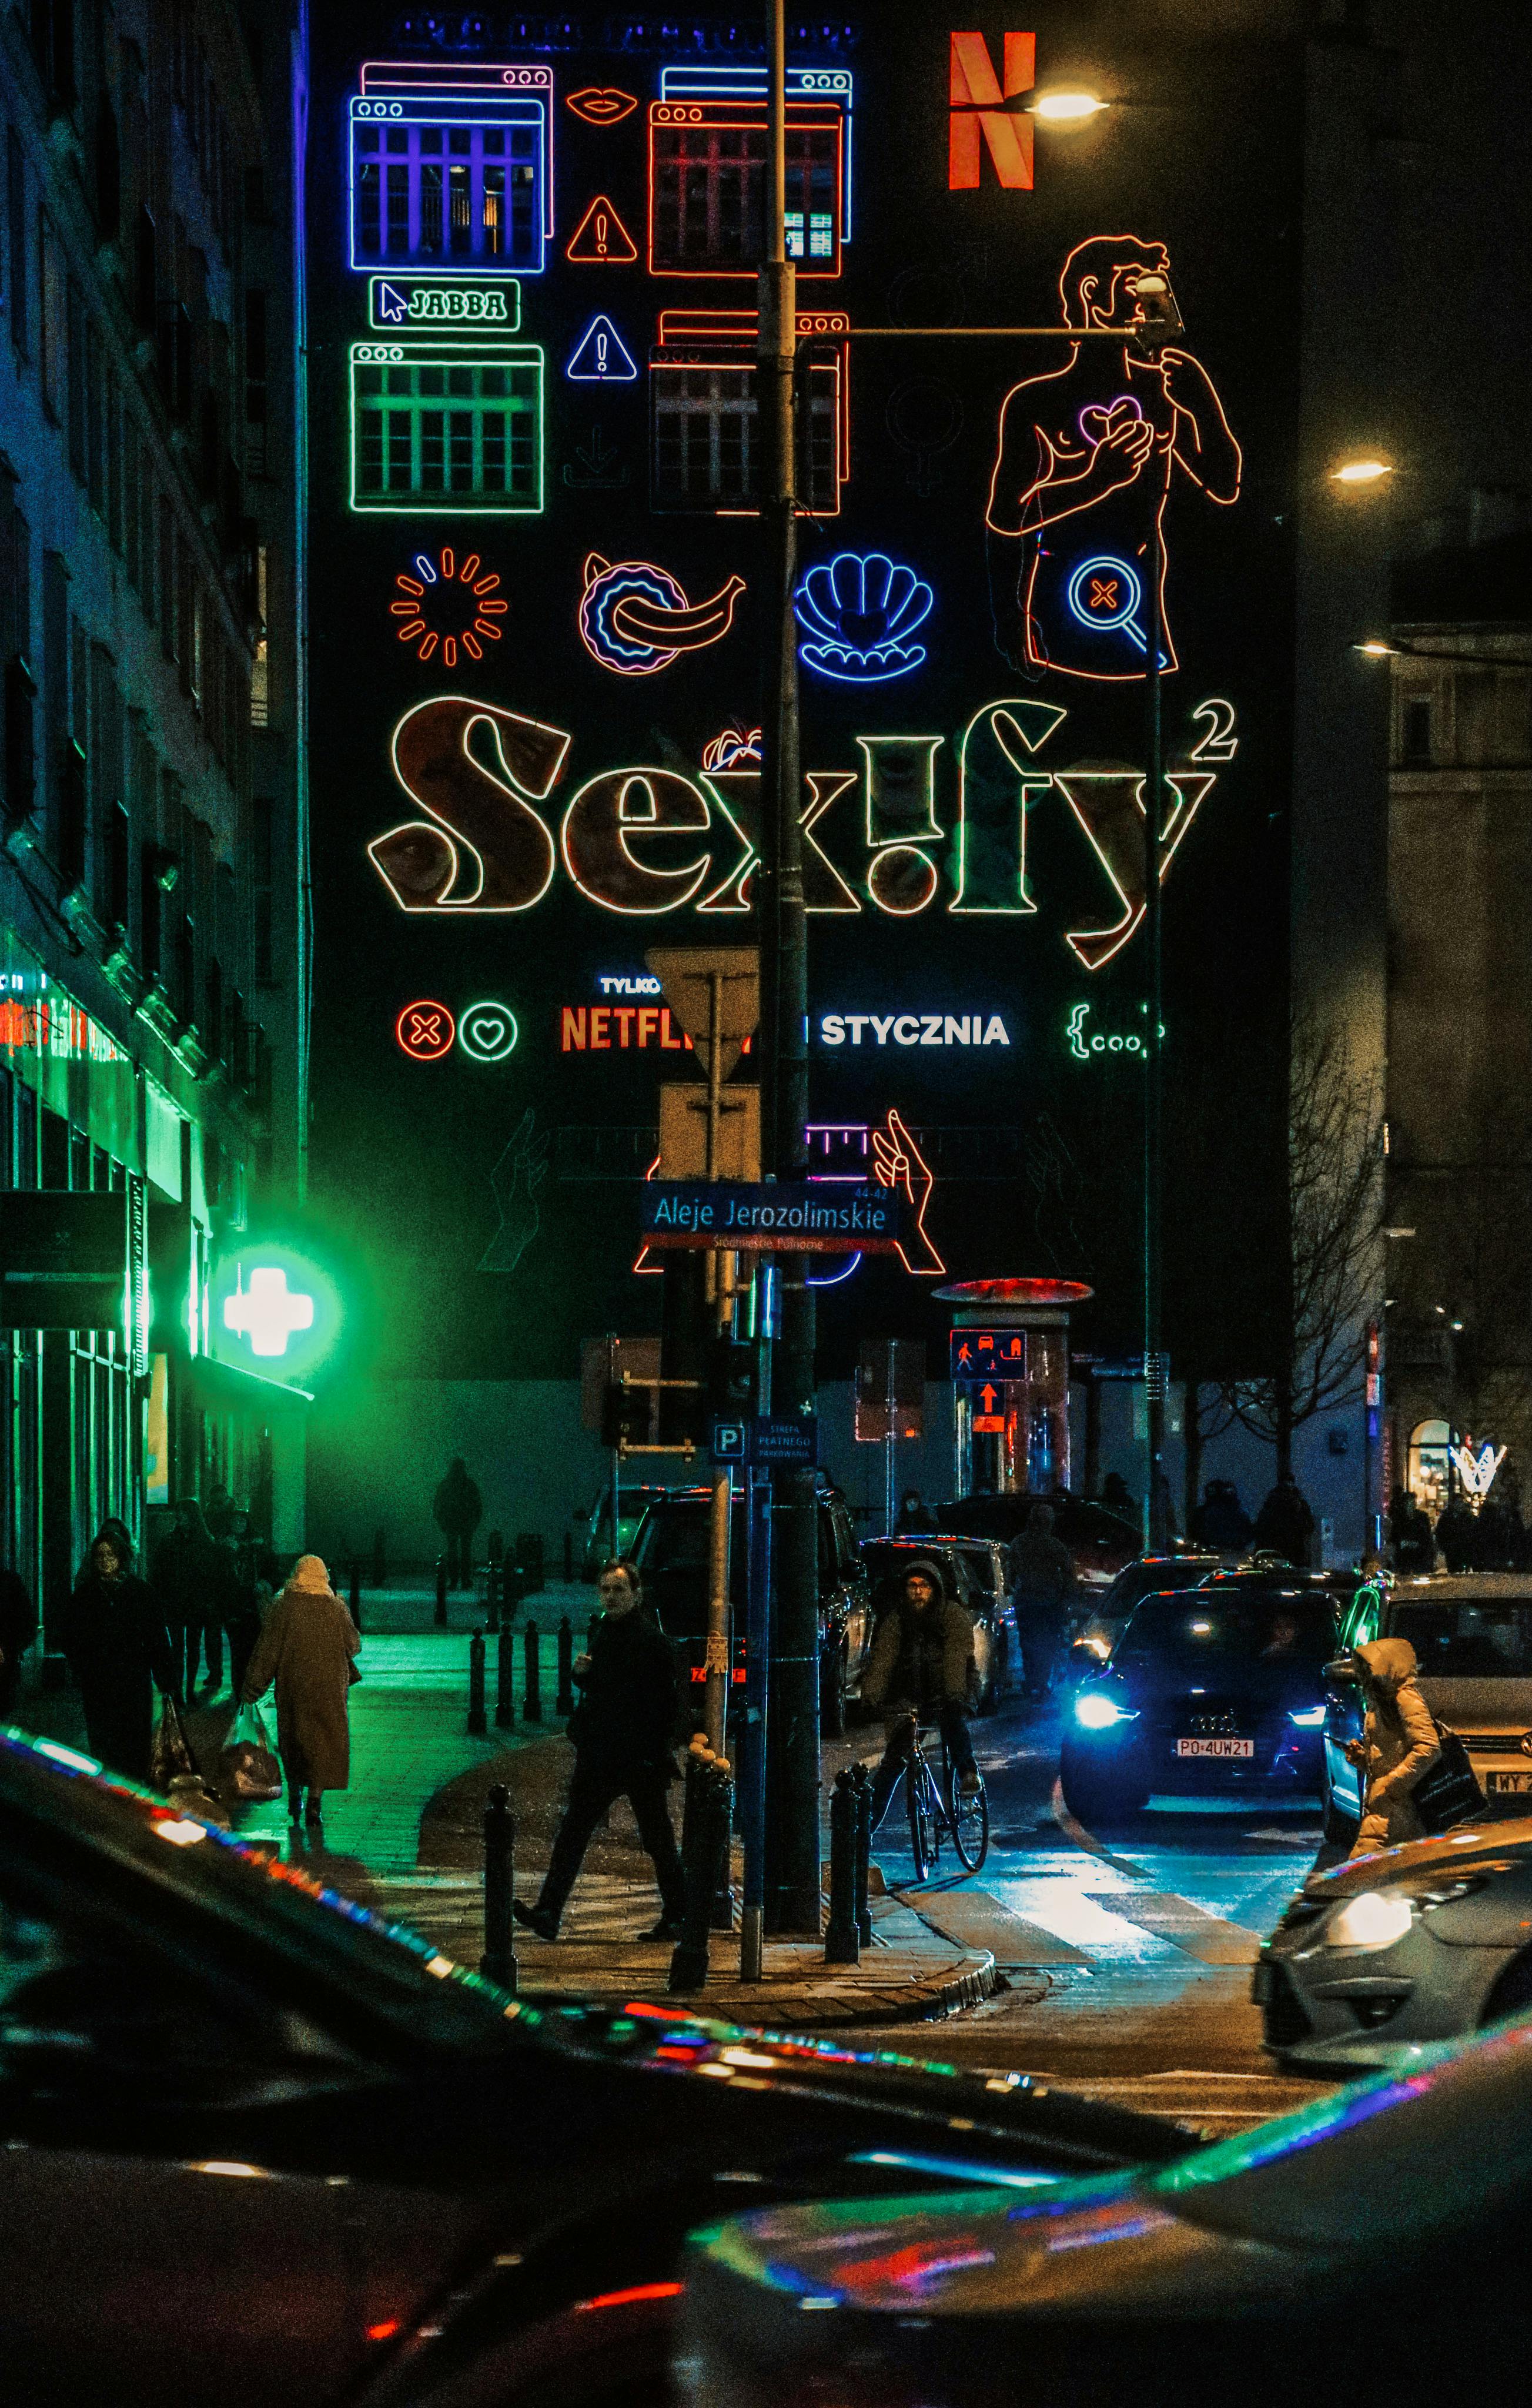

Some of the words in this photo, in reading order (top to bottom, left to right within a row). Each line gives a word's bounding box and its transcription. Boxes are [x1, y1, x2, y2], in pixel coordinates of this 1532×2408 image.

[949, 32, 1036, 190] N
[407, 290, 507, 319] JABBA
[601, 978, 660, 994] TYLKO
[561, 1007, 694, 1051] NETFL
[822, 1015, 1010, 1045] STYCZNIA
[654, 1196, 714, 1232] Aleje
[725, 1200, 886, 1230] Jerozolimskie
[721, 1430, 738, 1451] P
[771, 1425, 800, 1433] STREFA
[1500, 1775, 1520, 1791] WY
